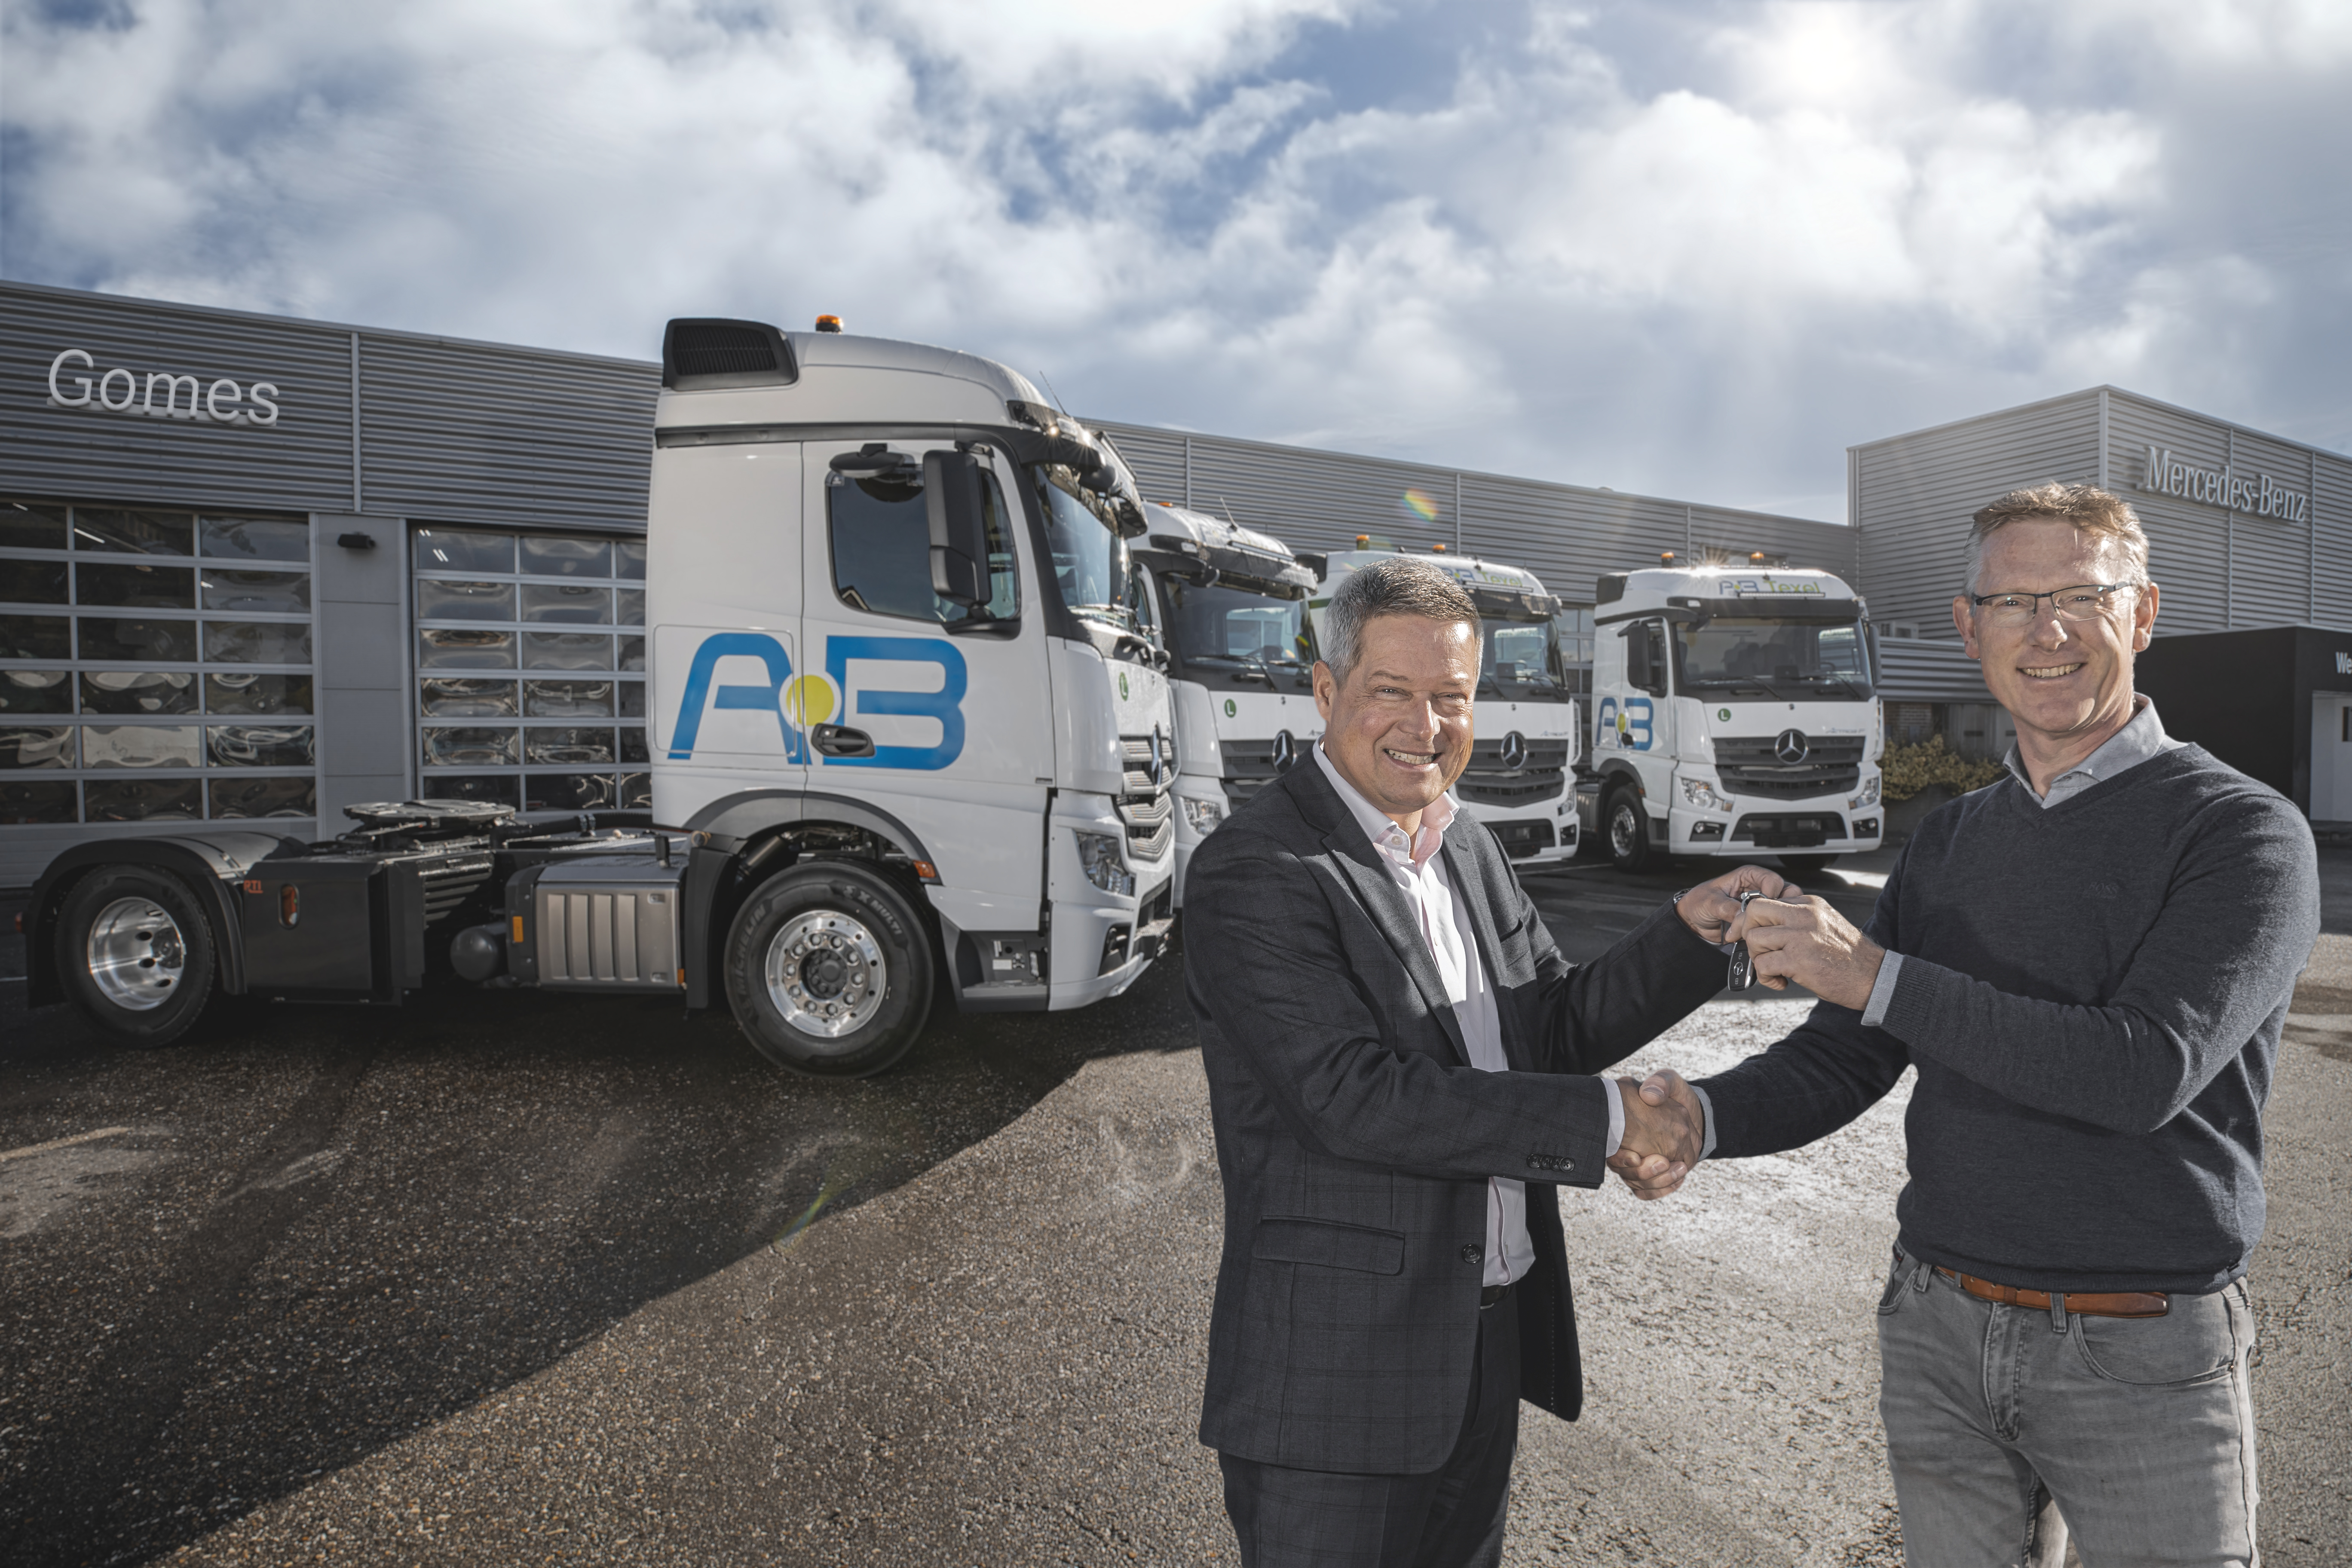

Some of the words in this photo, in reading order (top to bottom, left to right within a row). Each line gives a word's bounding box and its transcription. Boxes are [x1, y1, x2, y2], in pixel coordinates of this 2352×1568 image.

[49, 349, 279, 425] Gomes
[2146, 446, 2307, 522] Mercedes-Benz
[735, 903, 766, 995] MICHELIN
